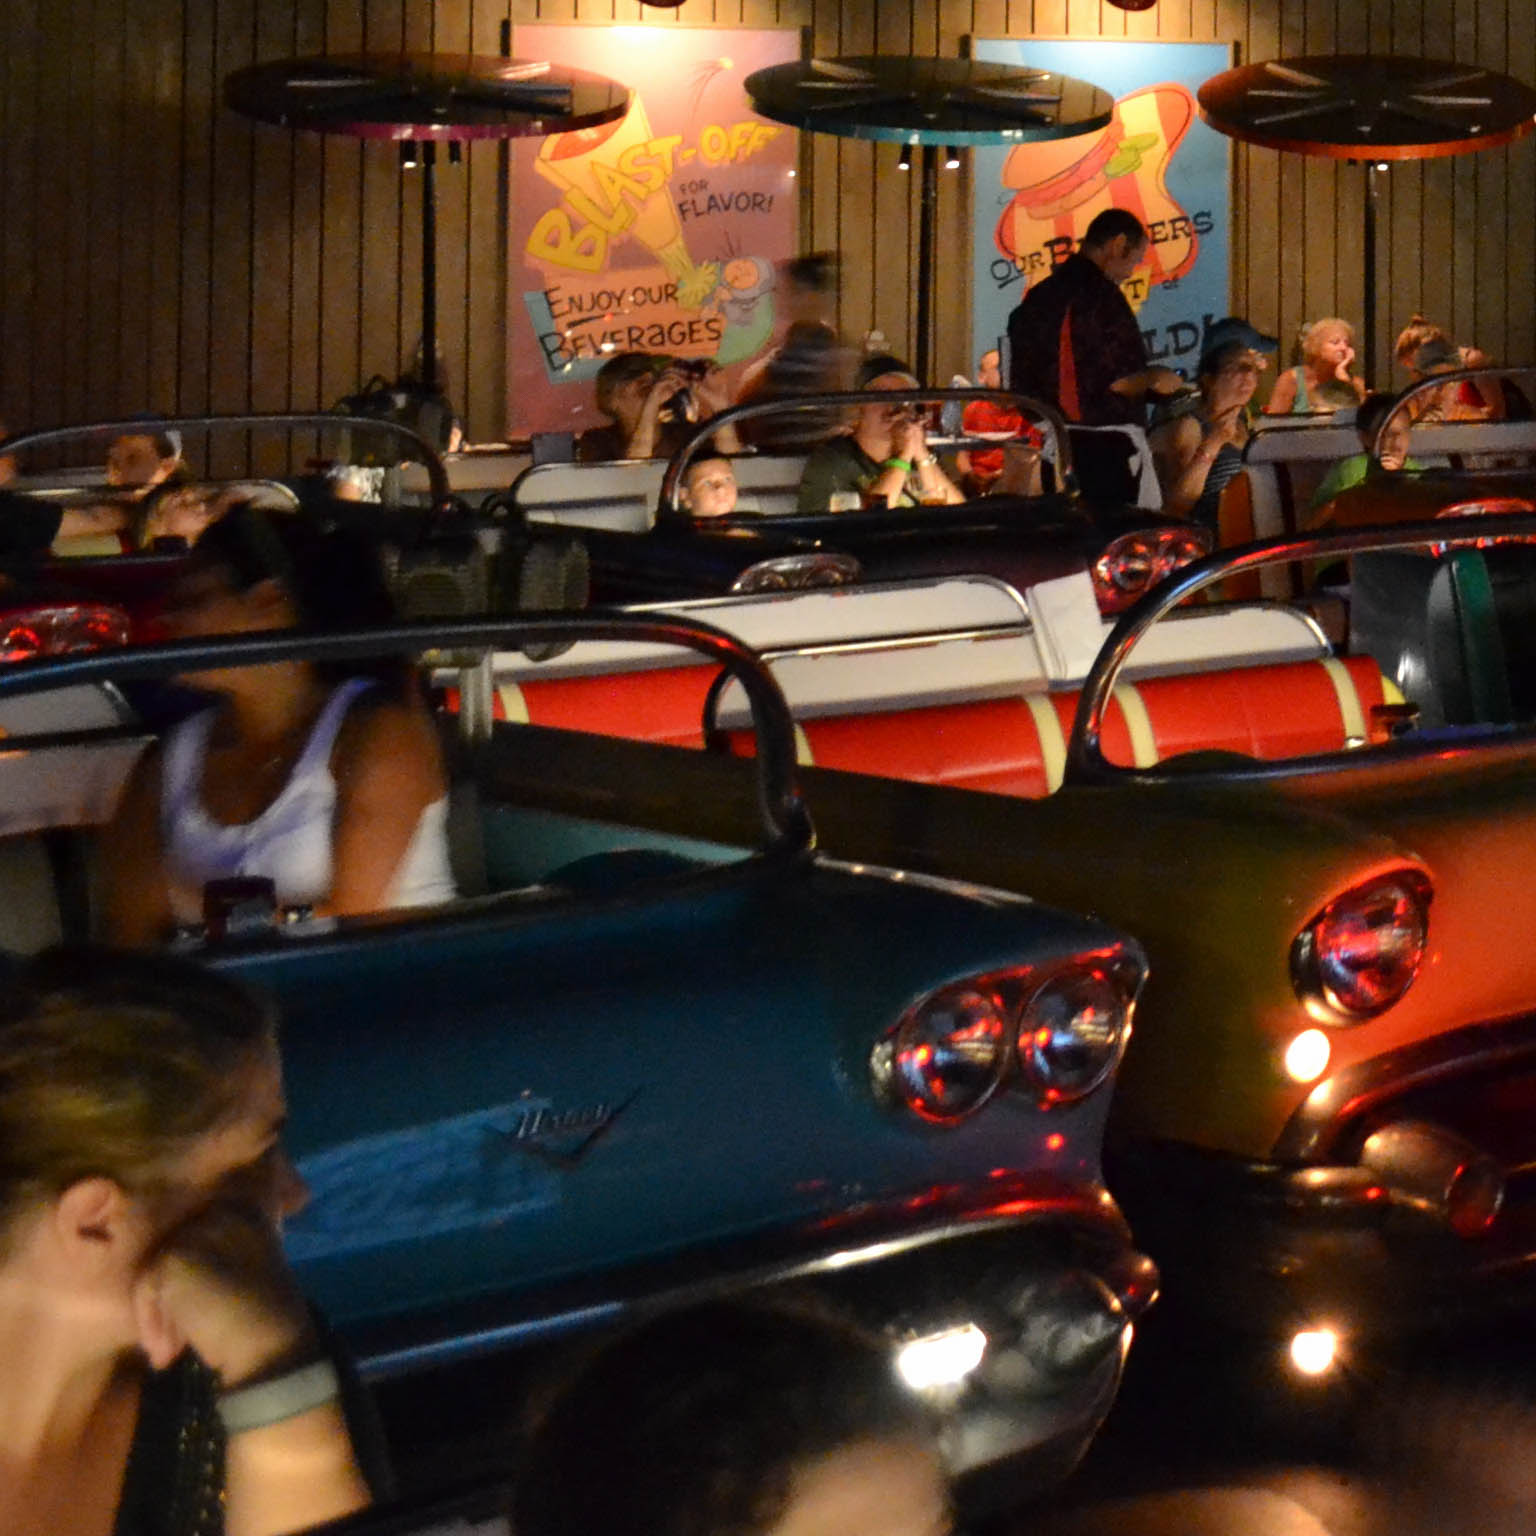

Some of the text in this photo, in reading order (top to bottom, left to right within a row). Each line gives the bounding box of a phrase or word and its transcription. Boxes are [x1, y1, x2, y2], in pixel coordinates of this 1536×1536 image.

[525, 120, 783, 273] BLAST-OFF
[679, 178, 709, 196] FOR
[678, 191, 775, 222] FLAVOR!
[990, 251, 1045, 289] OUR
[544, 282, 680, 319] ENJOY OUR
